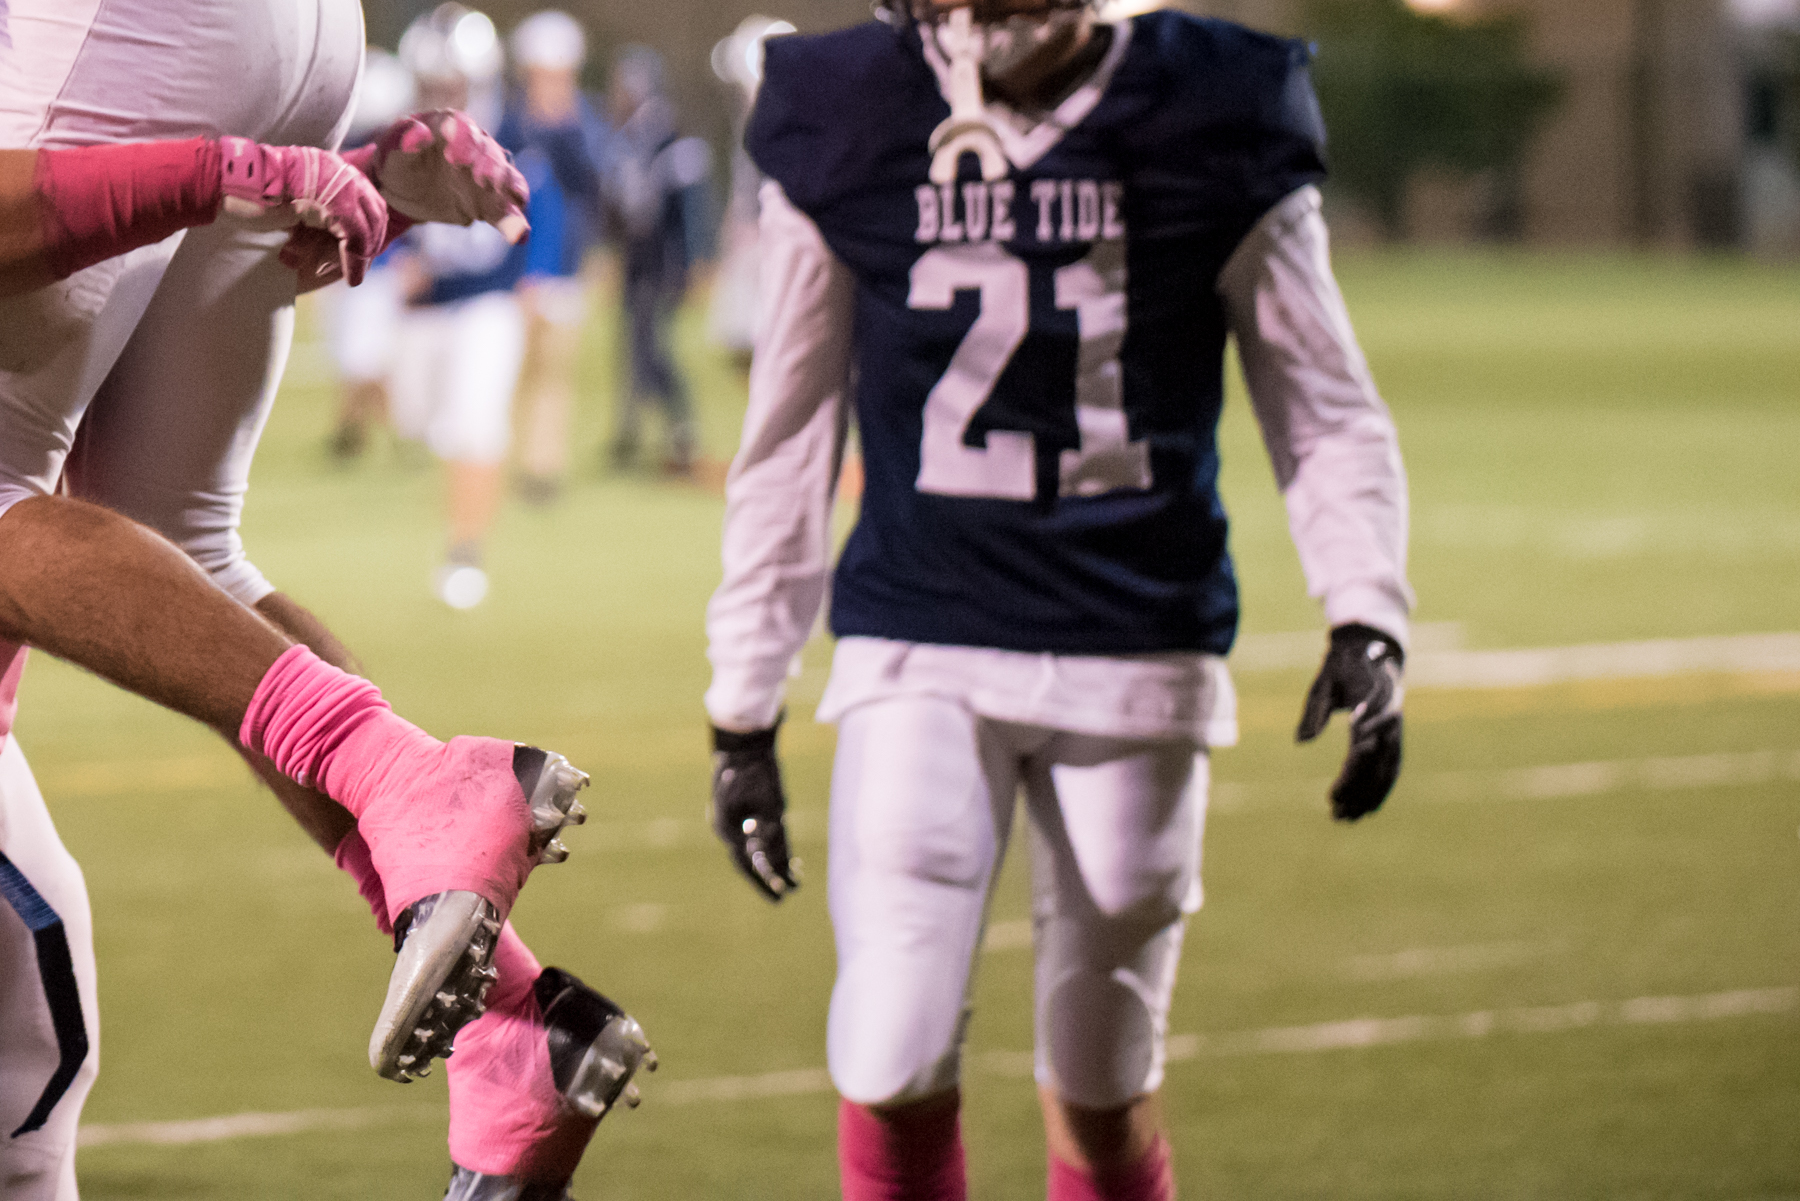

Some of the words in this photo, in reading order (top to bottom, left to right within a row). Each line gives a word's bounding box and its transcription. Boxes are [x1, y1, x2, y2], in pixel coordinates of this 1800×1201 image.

[914, 179, 1016, 242] BLUE
[1030, 177, 1125, 242] TIDE
[906, 244, 1153, 502] 21
